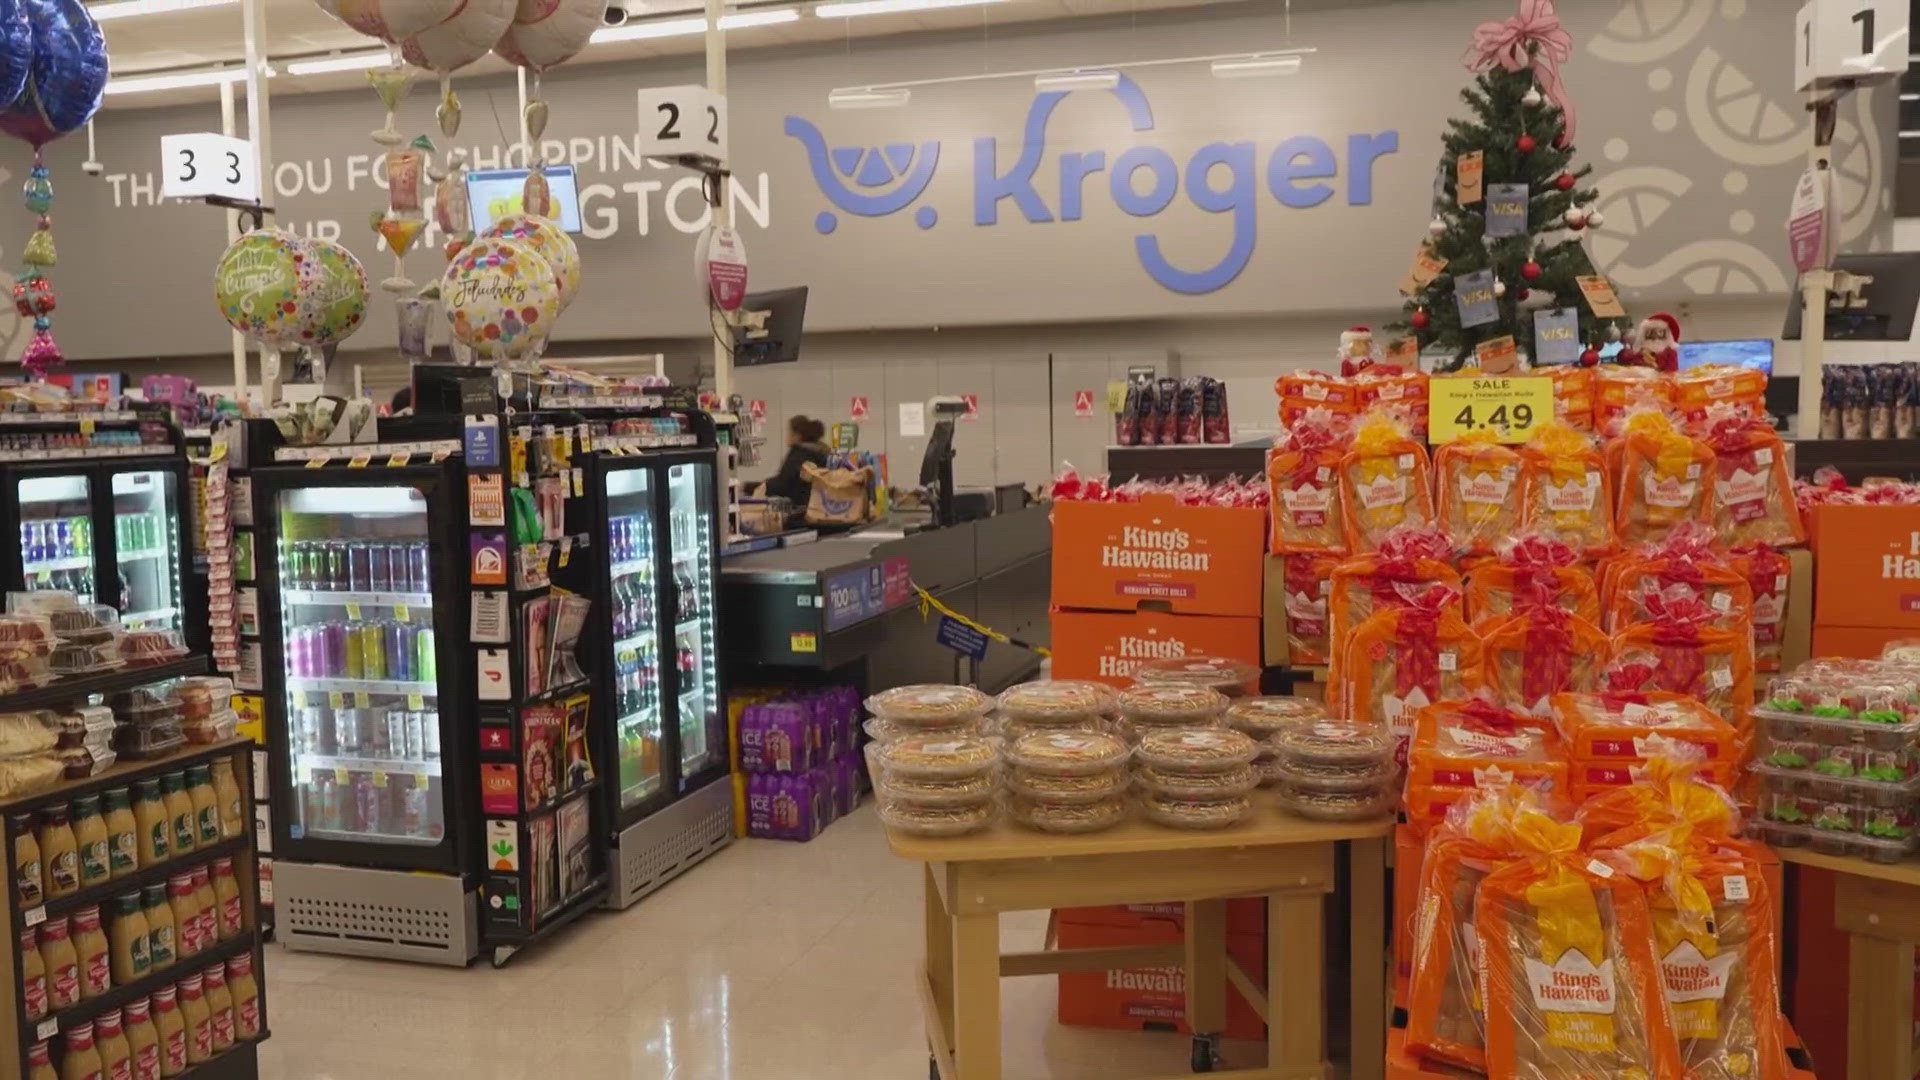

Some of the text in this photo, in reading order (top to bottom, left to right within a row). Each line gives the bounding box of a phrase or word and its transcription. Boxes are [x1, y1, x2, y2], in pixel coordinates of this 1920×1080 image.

[1803, 9, 1875, 66] 1 1
[657, 103, 680, 140] 2
[707, 105, 719, 144] 2
[179, 149, 196, 182] 3
[226, 151, 241, 184] 3
[447, 135, 672, 176] SHOPPIN
[974, 69, 1398, 295] Kroger
[1492, 203, 1523, 216] VISA
[454, 275, 527, 307] Felicidades
[1461, 290, 1492, 307] VISA
[1541, 326, 1574, 341] VISA
[1473, 380, 1510, 389] SALE
[1454, 404, 1533, 430] 4.49
[1123, 525, 1189, 550] King's
[1102, 545, 1209, 571] Hawaiian
[1120, 636, 1184, 658] King's
[742, 732, 762, 746] ICE
[751, 800, 769, 812] ICE
[1107, 969, 1185, 993] Hawaii
[1553, 972, 1601, 988] King's
[1662, 964, 1710, 979] King's
